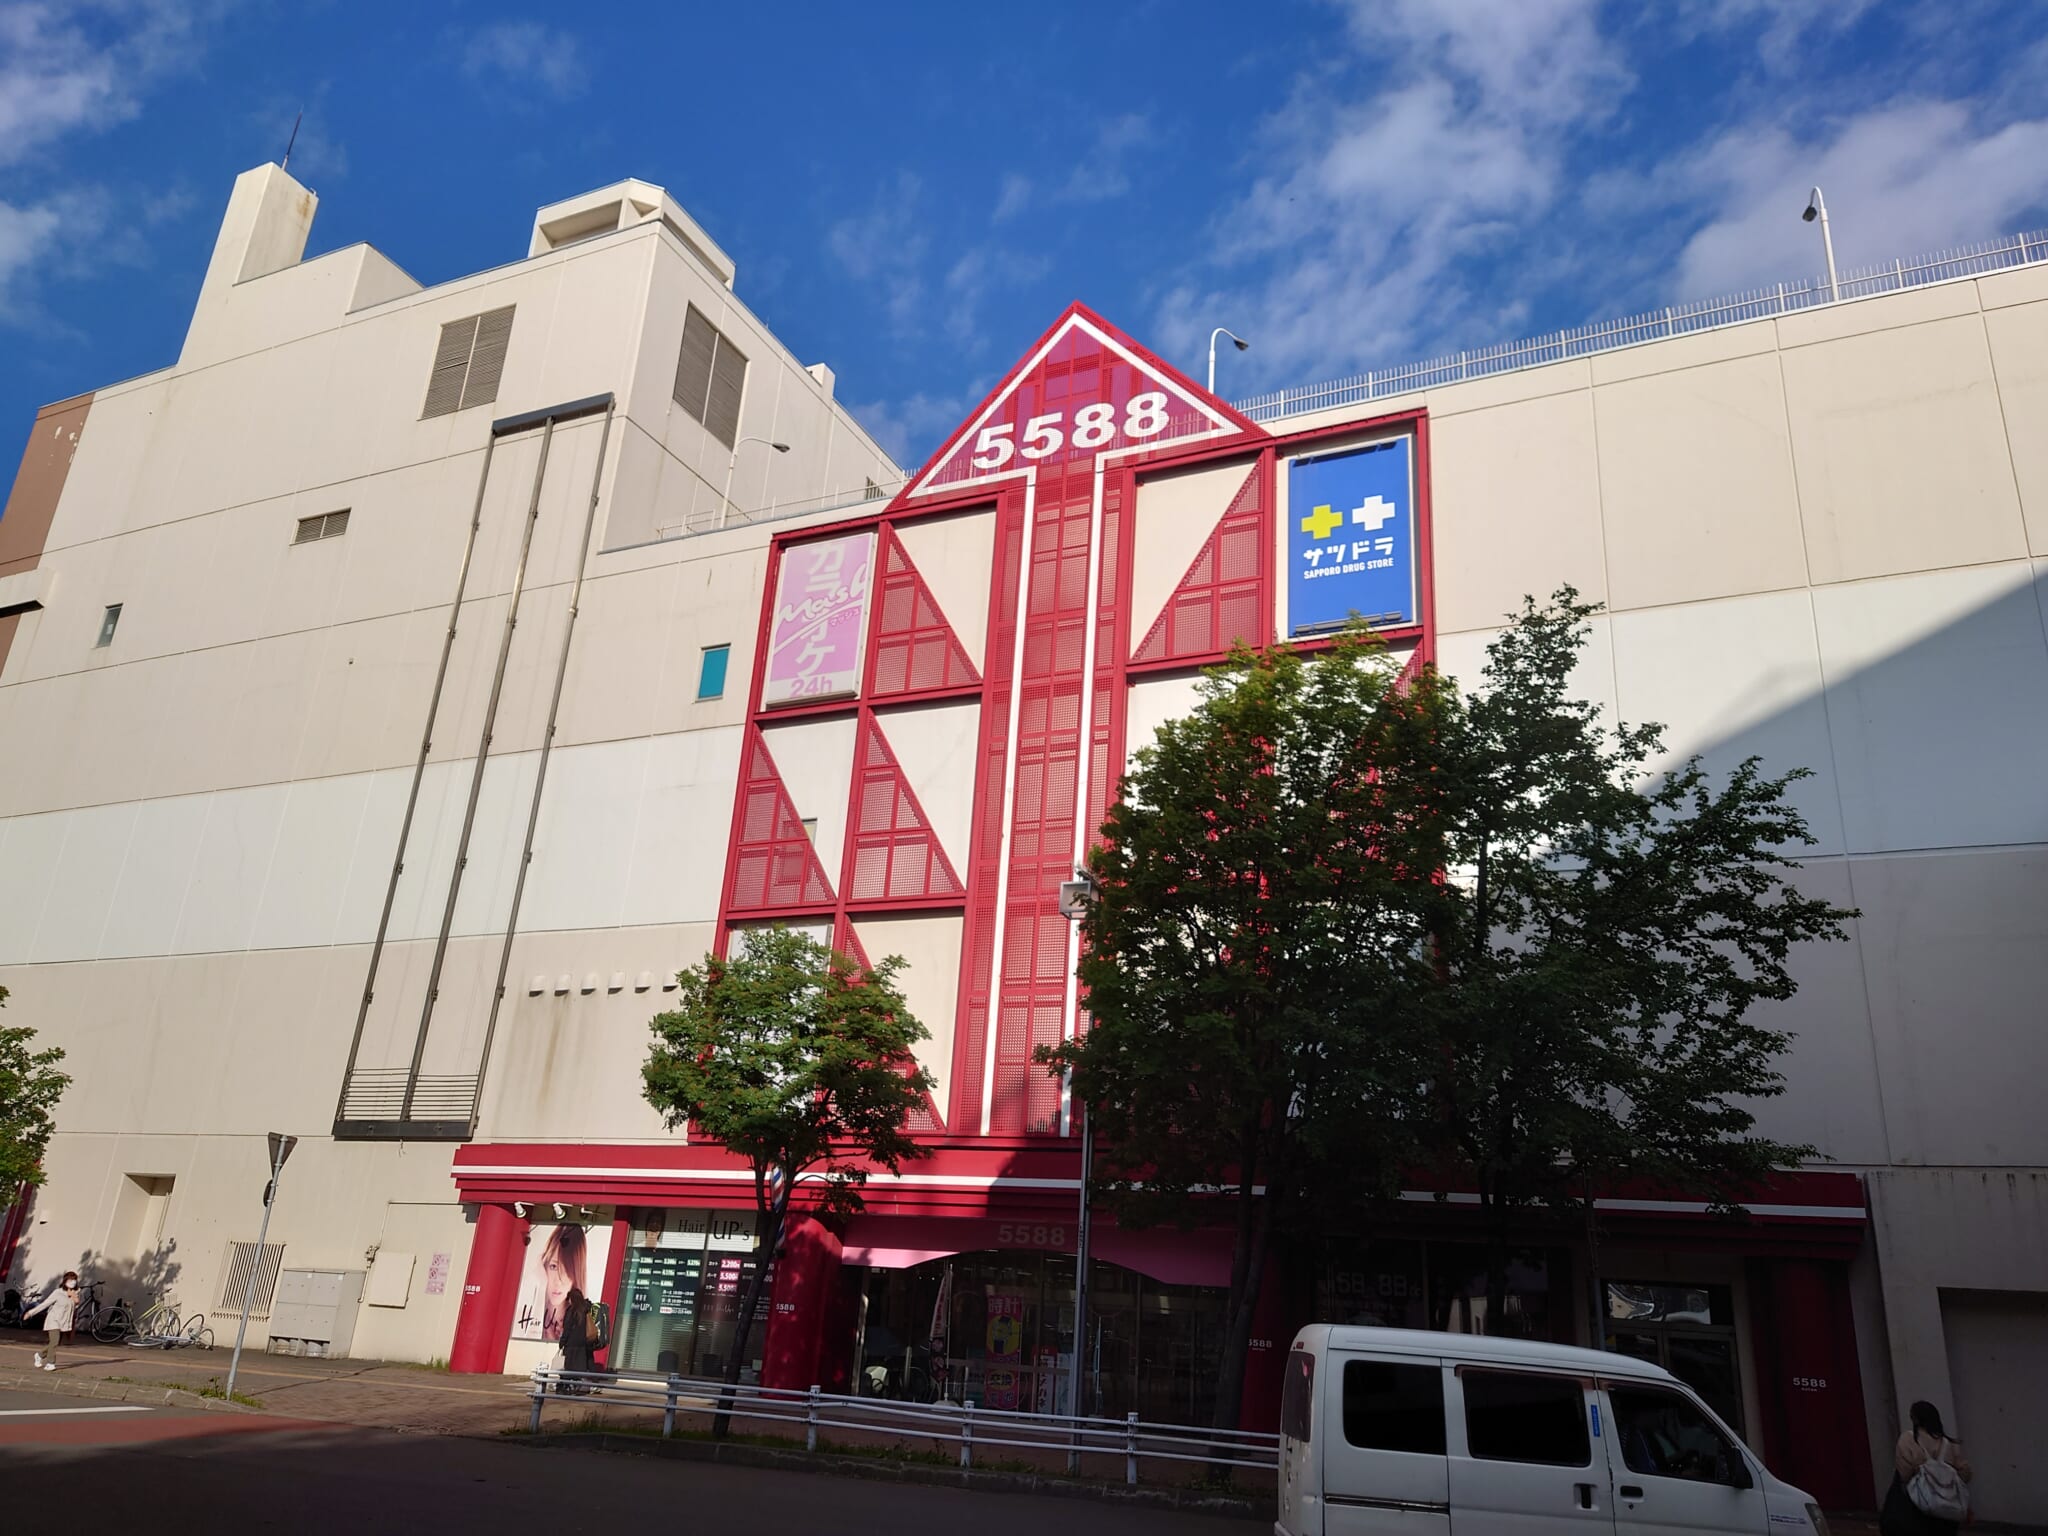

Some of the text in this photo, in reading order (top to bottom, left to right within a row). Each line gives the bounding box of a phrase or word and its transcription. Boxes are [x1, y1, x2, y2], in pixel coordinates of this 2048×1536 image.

[972, 392, 1170, 469] 5588
[1303, 537, 1394, 567] サツドラ
[1304, 557, 1394, 580] SAPPORO DRUG STORE
[791, 675, 833, 698] 24h
[679, 1218, 751, 1241] Hair UP's
[998, 1225, 1065, 1246] 5588
[988, 1298, 1020, 1314] 時計
[1793, 1376, 1827, 1388] 5588
